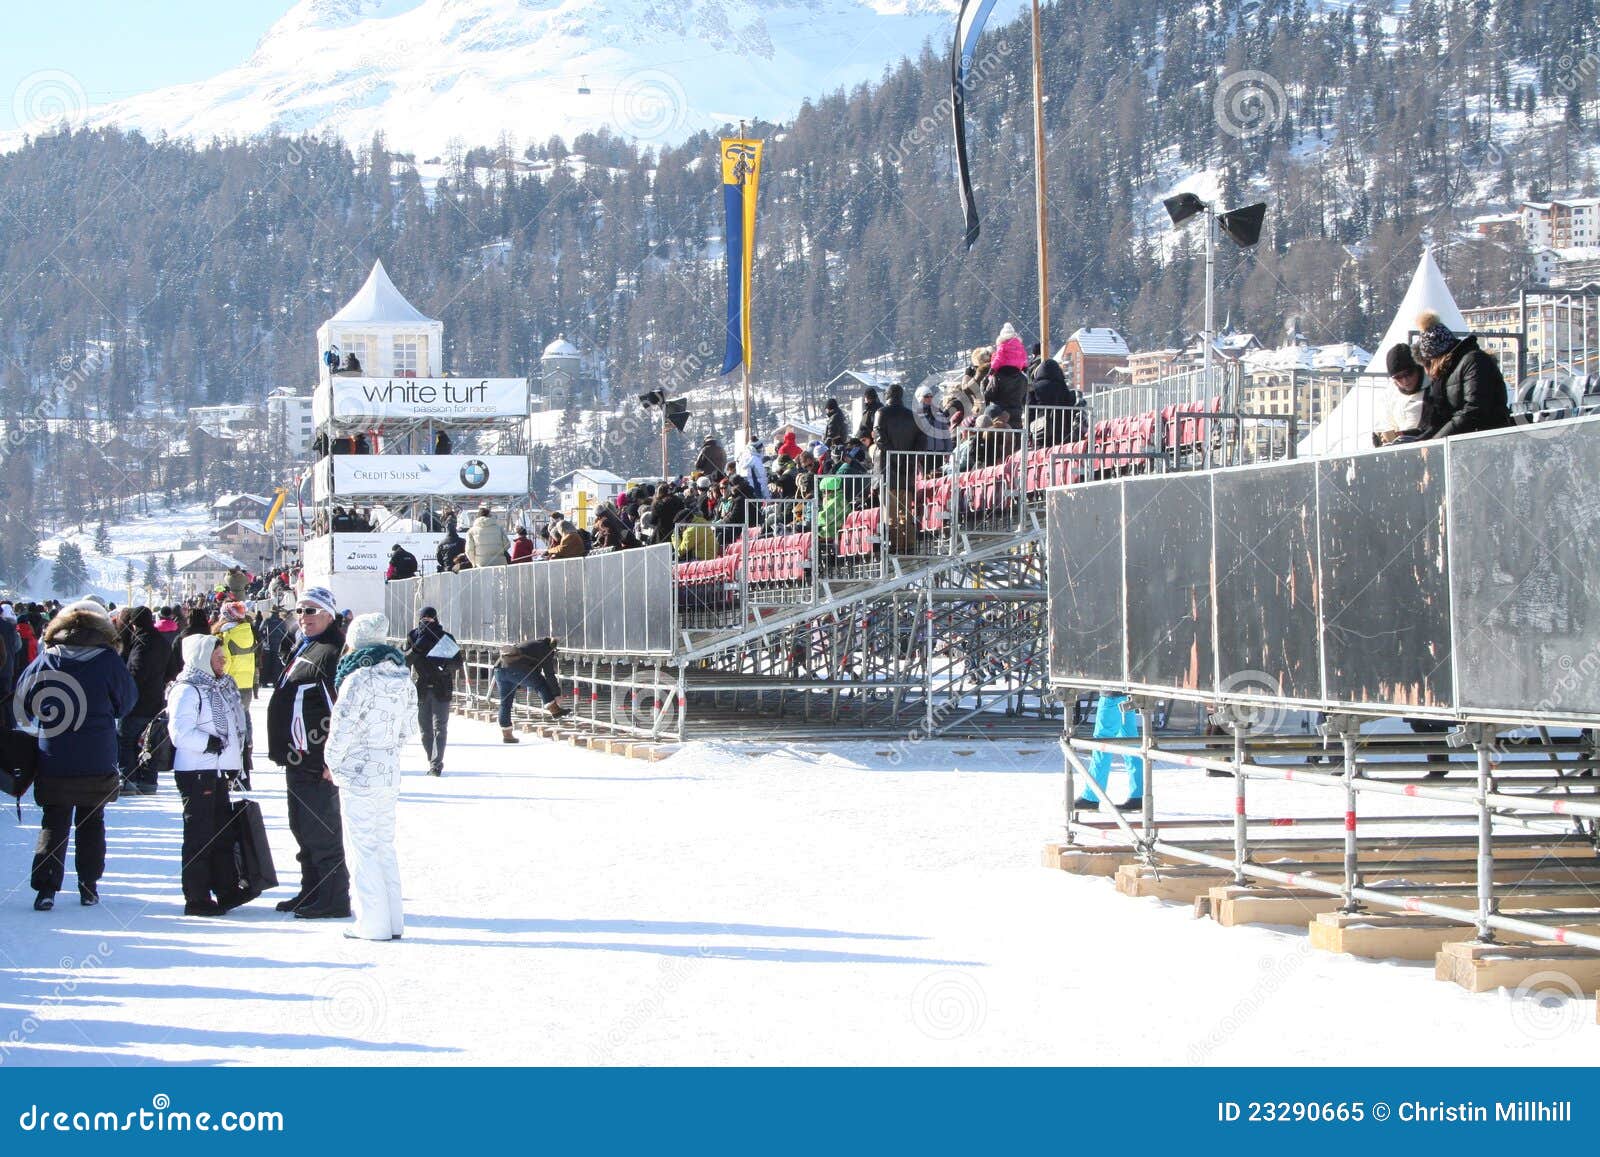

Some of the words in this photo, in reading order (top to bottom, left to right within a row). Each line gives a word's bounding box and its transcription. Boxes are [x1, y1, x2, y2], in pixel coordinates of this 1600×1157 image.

[363, 380, 437, 403] white
[442, 380, 489, 403] turf
[413, 404, 452, 413] passion
[454, 404, 468, 412] for
[469, 404, 497, 413] races
[353, 470, 388, 480] CREDIT
[390, 470, 420, 480] SUISSE
